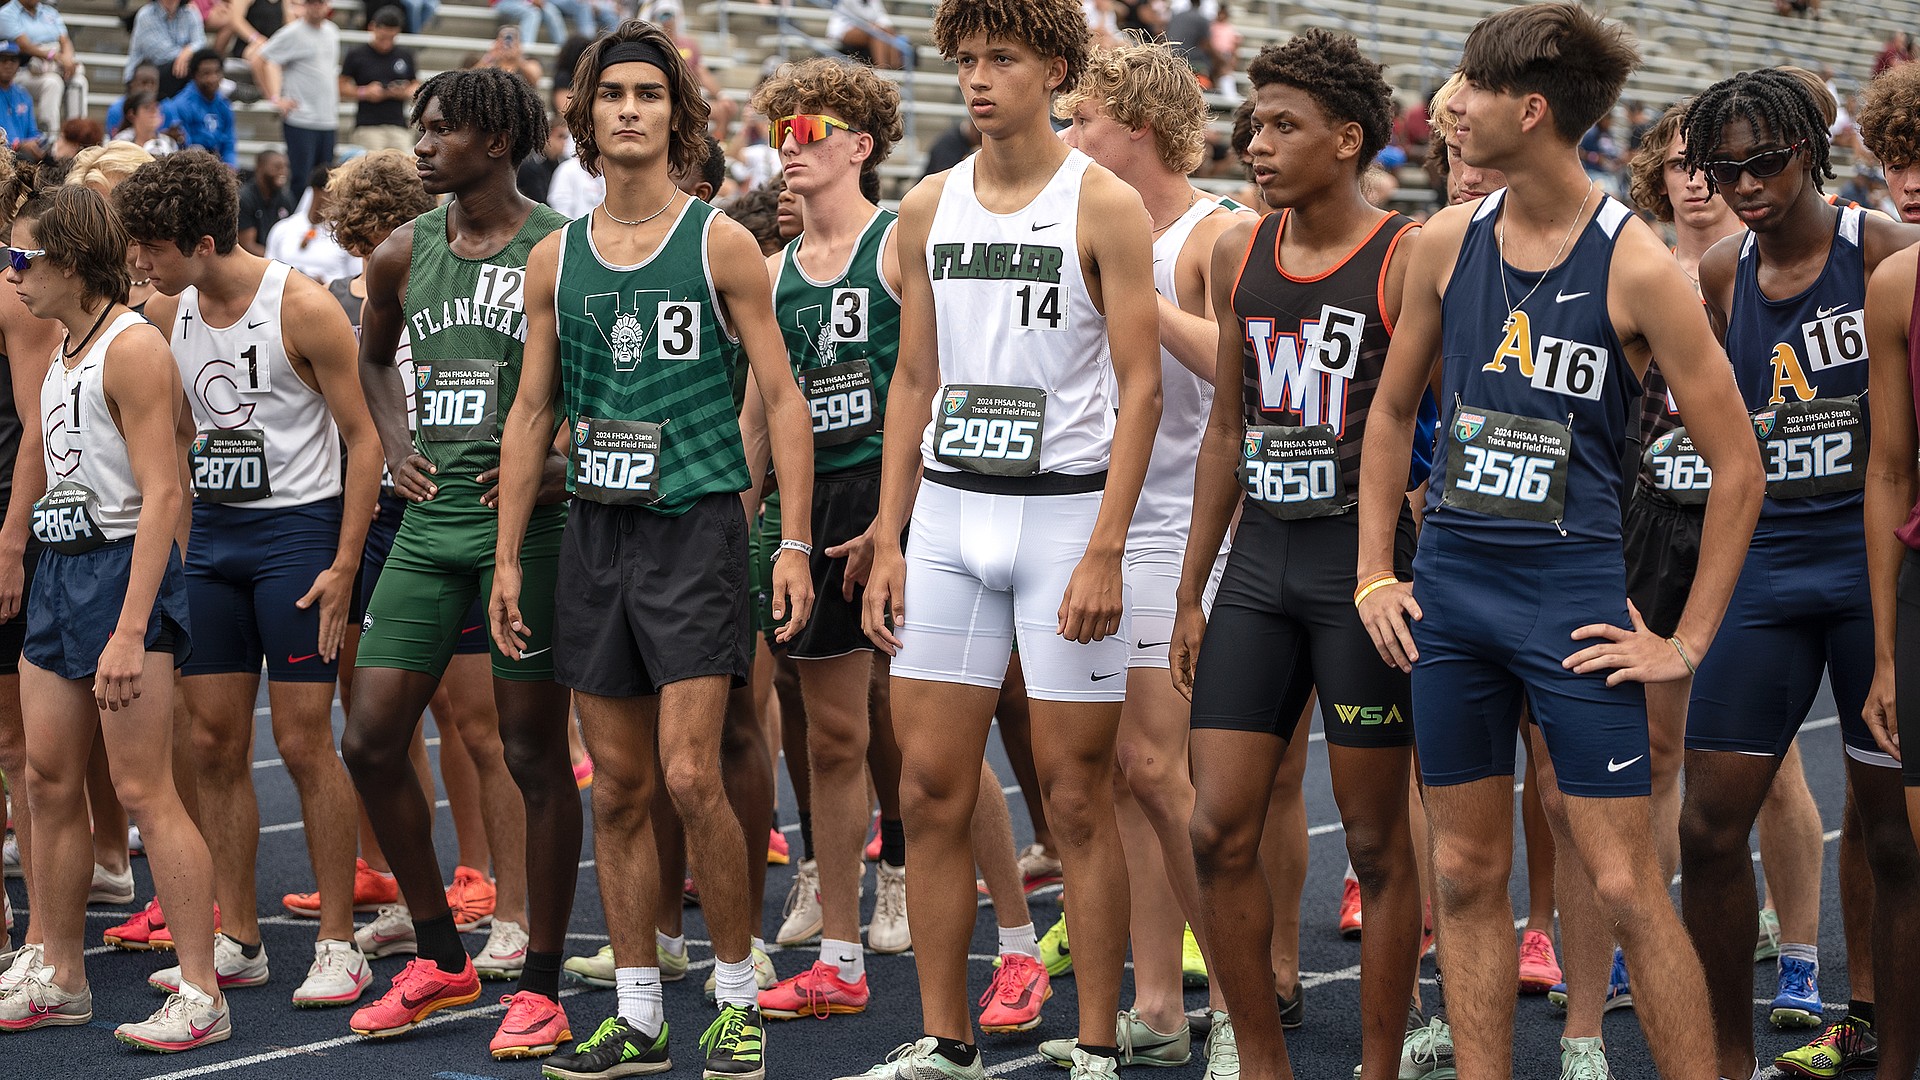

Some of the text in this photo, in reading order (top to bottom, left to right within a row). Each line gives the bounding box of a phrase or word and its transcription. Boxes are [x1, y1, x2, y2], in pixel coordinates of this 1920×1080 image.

[933, 242, 1063, 284] FLAGLER
[483, 268, 522, 308] 12
[1016, 285, 1061, 328] 14
[412, 297, 529, 345] FLANAGAN
[663, 305, 694, 356] 3
[835, 292, 861, 338] 3
[1319, 312, 1356, 369] 5
[1482, 310, 1535, 378] A
[1808, 316, 1864, 366] 16
[240, 345, 258, 389] 1
[847, 372, 863, 380] State
[852, 378, 870, 387] Finals
[1543, 341, 1597, 394] 16
[1768, 342, 1818, 405] A
[70, 381, 81, 427] 1
[194, 359, 257, 430] C
[421, 389, 487, 427] 3013
[807, 388, 873, 433] 599
[1018, 400, 1036, 408] State
[1021, 409, 1041, 417] Finals
[939, 417, 1039, 460] 2995
[1494, 427, 1561, 445] 2024 FHSAA State
[1782, 417, 1859, 434] Track and Field Finals
[1787, 410, 1851, 424] 2024 FHSAA State
[1313, 447, 1335, 455] Finals
[1487, 436, 1566, 456] Track and Field Finals
[1766, 431, 1853, 482] 3512
[194, 456, 262, 490] 2870
[577, 447, 656, 490] 3602
[1246, 460, 1336, 503] 3650
[1456, 444, 1555, 503] 3516
[1652, 455, 1712, 490] 365
[32, 507, 92, 543] 2864
[1333, 703, 1404, 725] WSA
